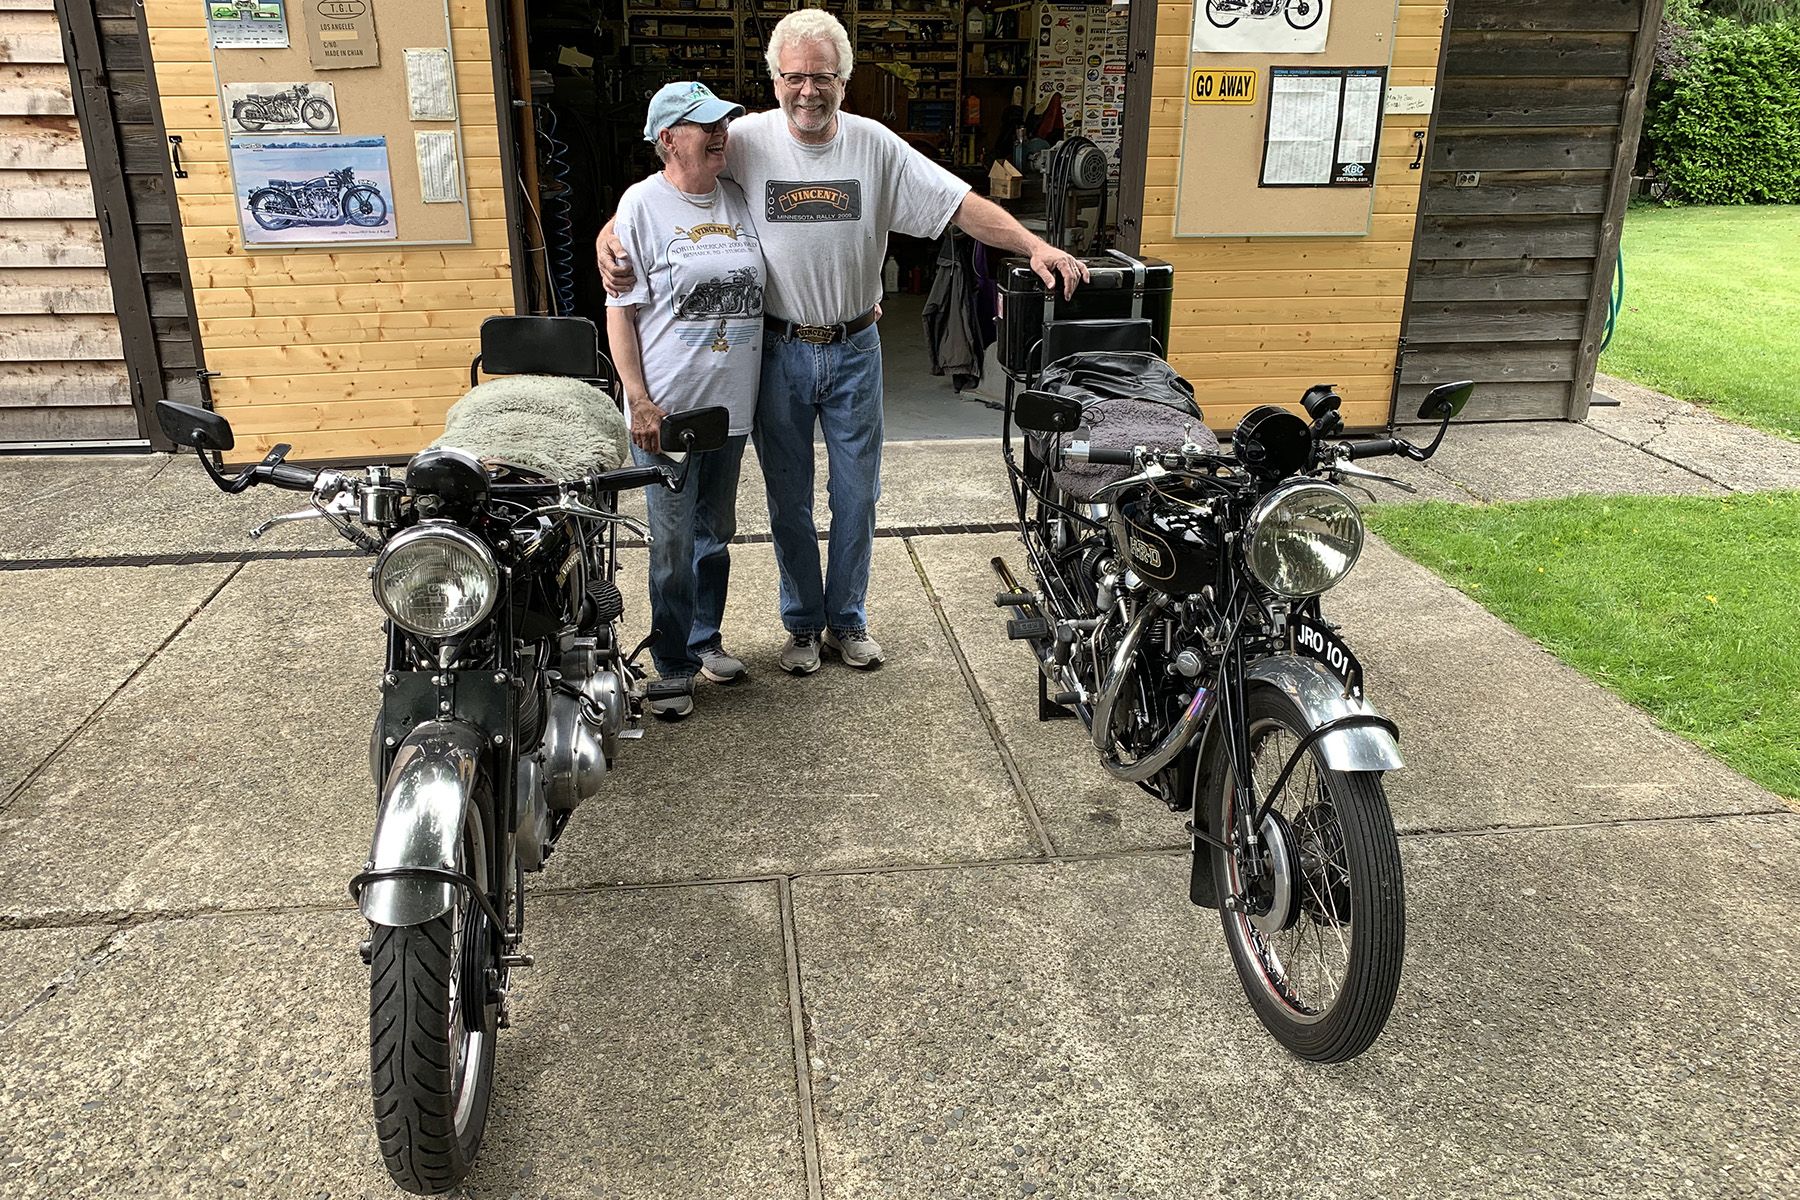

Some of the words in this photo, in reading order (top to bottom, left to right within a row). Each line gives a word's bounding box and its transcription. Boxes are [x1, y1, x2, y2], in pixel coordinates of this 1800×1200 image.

[330, 4, 353, 13] T.G.L
[1197, 75, 1213, 97] GO
[1218, 75, 1252, 97] AWAY
[1344, 165, 1364, 174] KBC
[791, 189, 839, 202] VINCENT
[695, 226, 730, 236] VINCENT
[671, 245, 695, 256] NORTH
[696, 242, 727, 251] AMERICAN
[799, 330, 833, 339] VINCENT
[1297, 624, 1324, 653] JRO
[1326, 641, 1349, 676] 101
